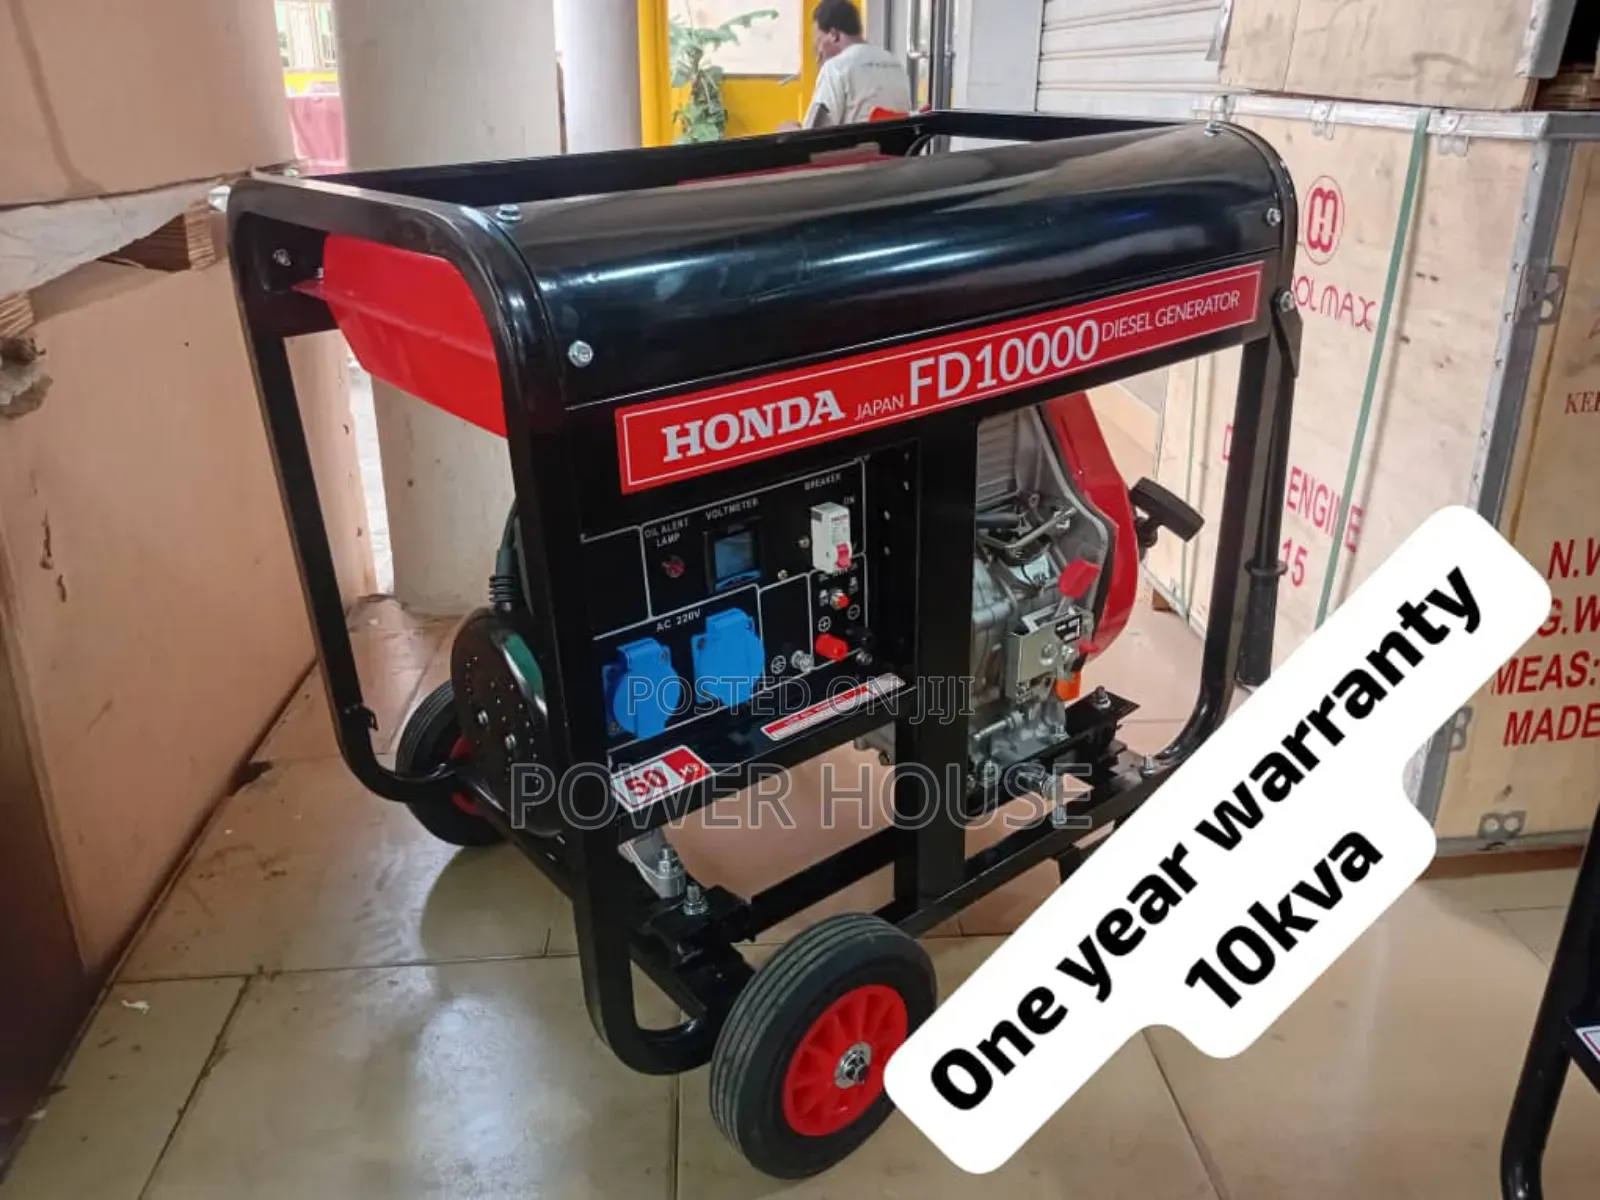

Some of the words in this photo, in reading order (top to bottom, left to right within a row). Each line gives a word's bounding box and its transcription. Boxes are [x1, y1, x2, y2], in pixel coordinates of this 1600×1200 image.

[1291, 275, 1376, 332] OLMAX
[661, 390, 846, 462] HONDA
[854, 394, 904, 421] JAPAN
[910, 320, 1099, 405] FD10000
[1102, 311, 1154, 342] DIESEL
[1155, 290, 1240, 326] GENERATOR
[804, 473, 841, 490] BREAKER
[705, 498, 760, 520] VOLTMETER
[656, 533, 681, 547] LAMP
[656, 619, 672, 632] AC
[676, 608, 701, 625] 220V
[1503, 702, 1600, 747] MADE
[625, 769, 668, 796] 50
